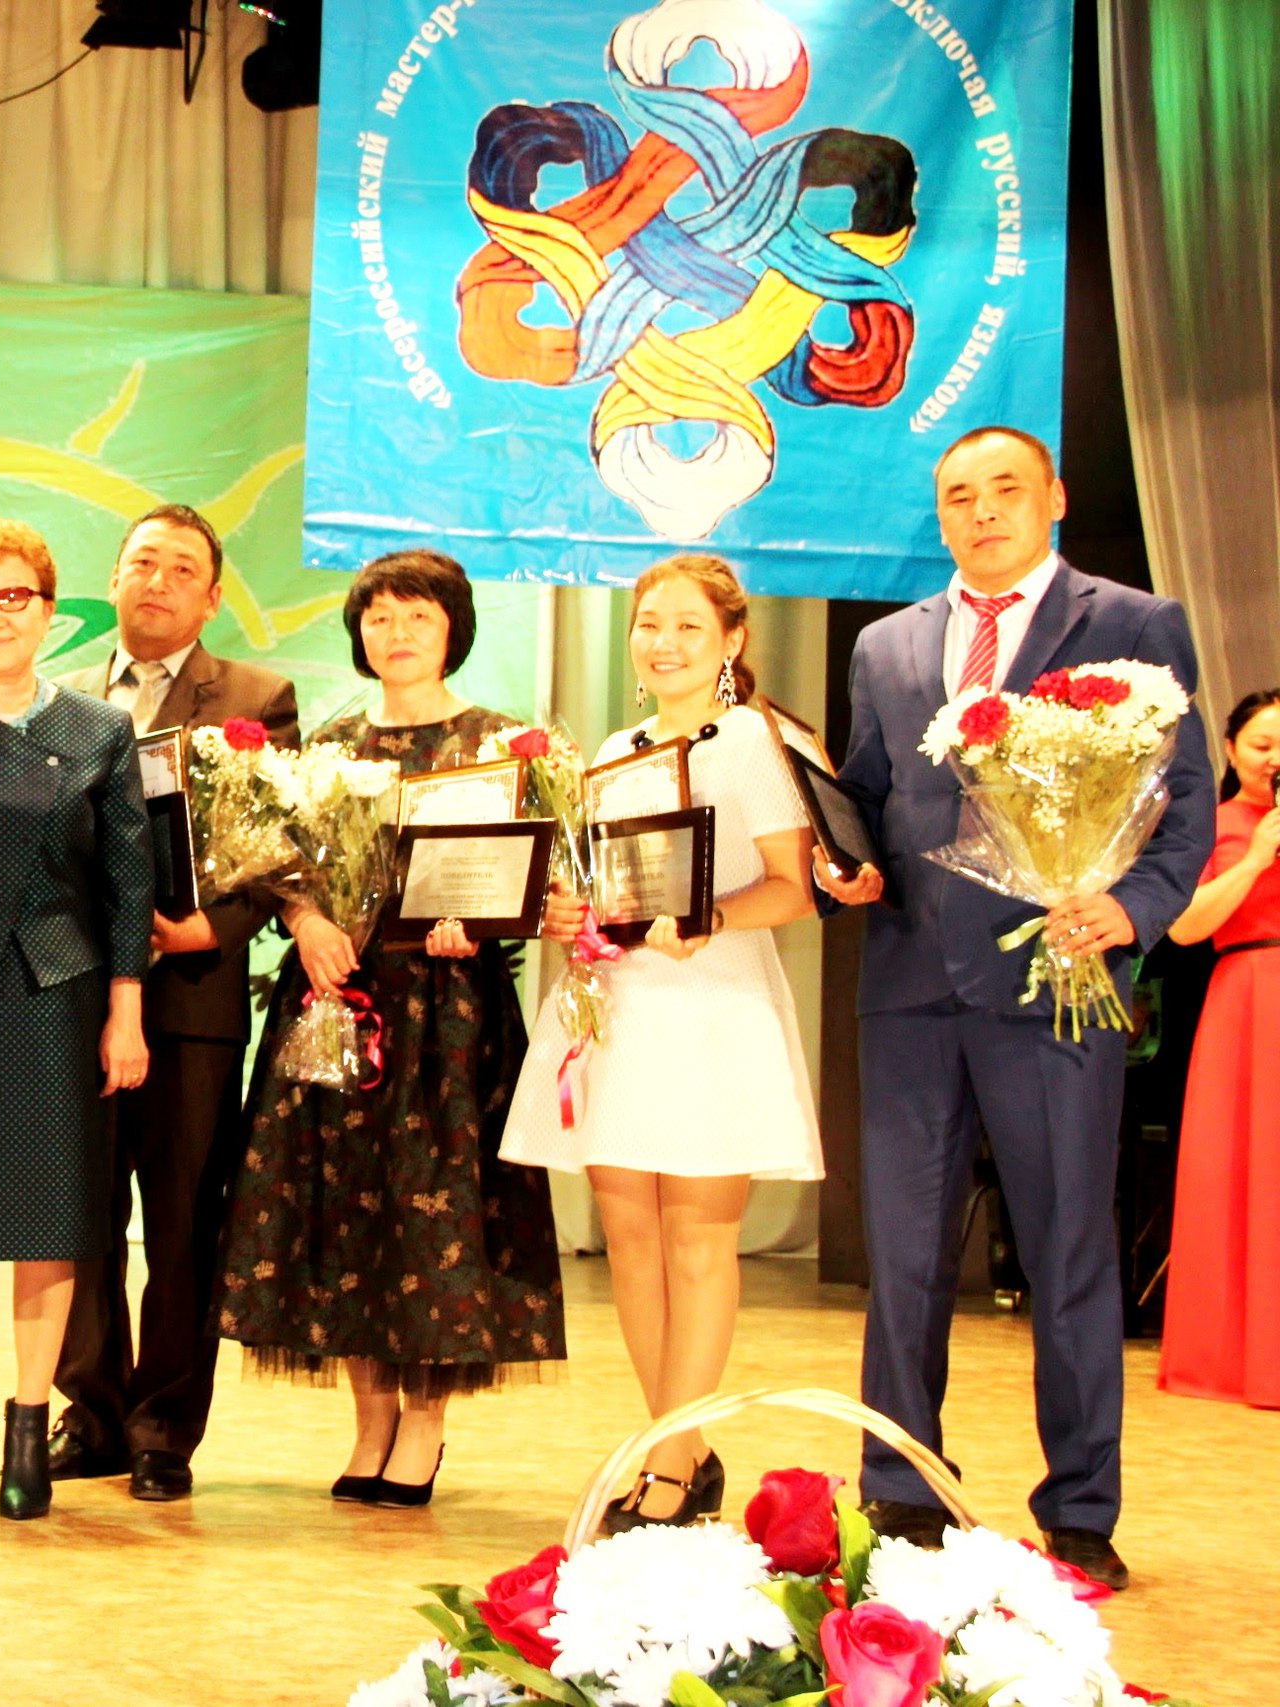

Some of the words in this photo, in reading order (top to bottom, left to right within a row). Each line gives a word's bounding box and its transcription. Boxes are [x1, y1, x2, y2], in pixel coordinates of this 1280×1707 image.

[350, 131, 452, 409] «Всероссийский
[975, 131, 1028, 286] русский,
[909, 303, 1007, 433] языков»
